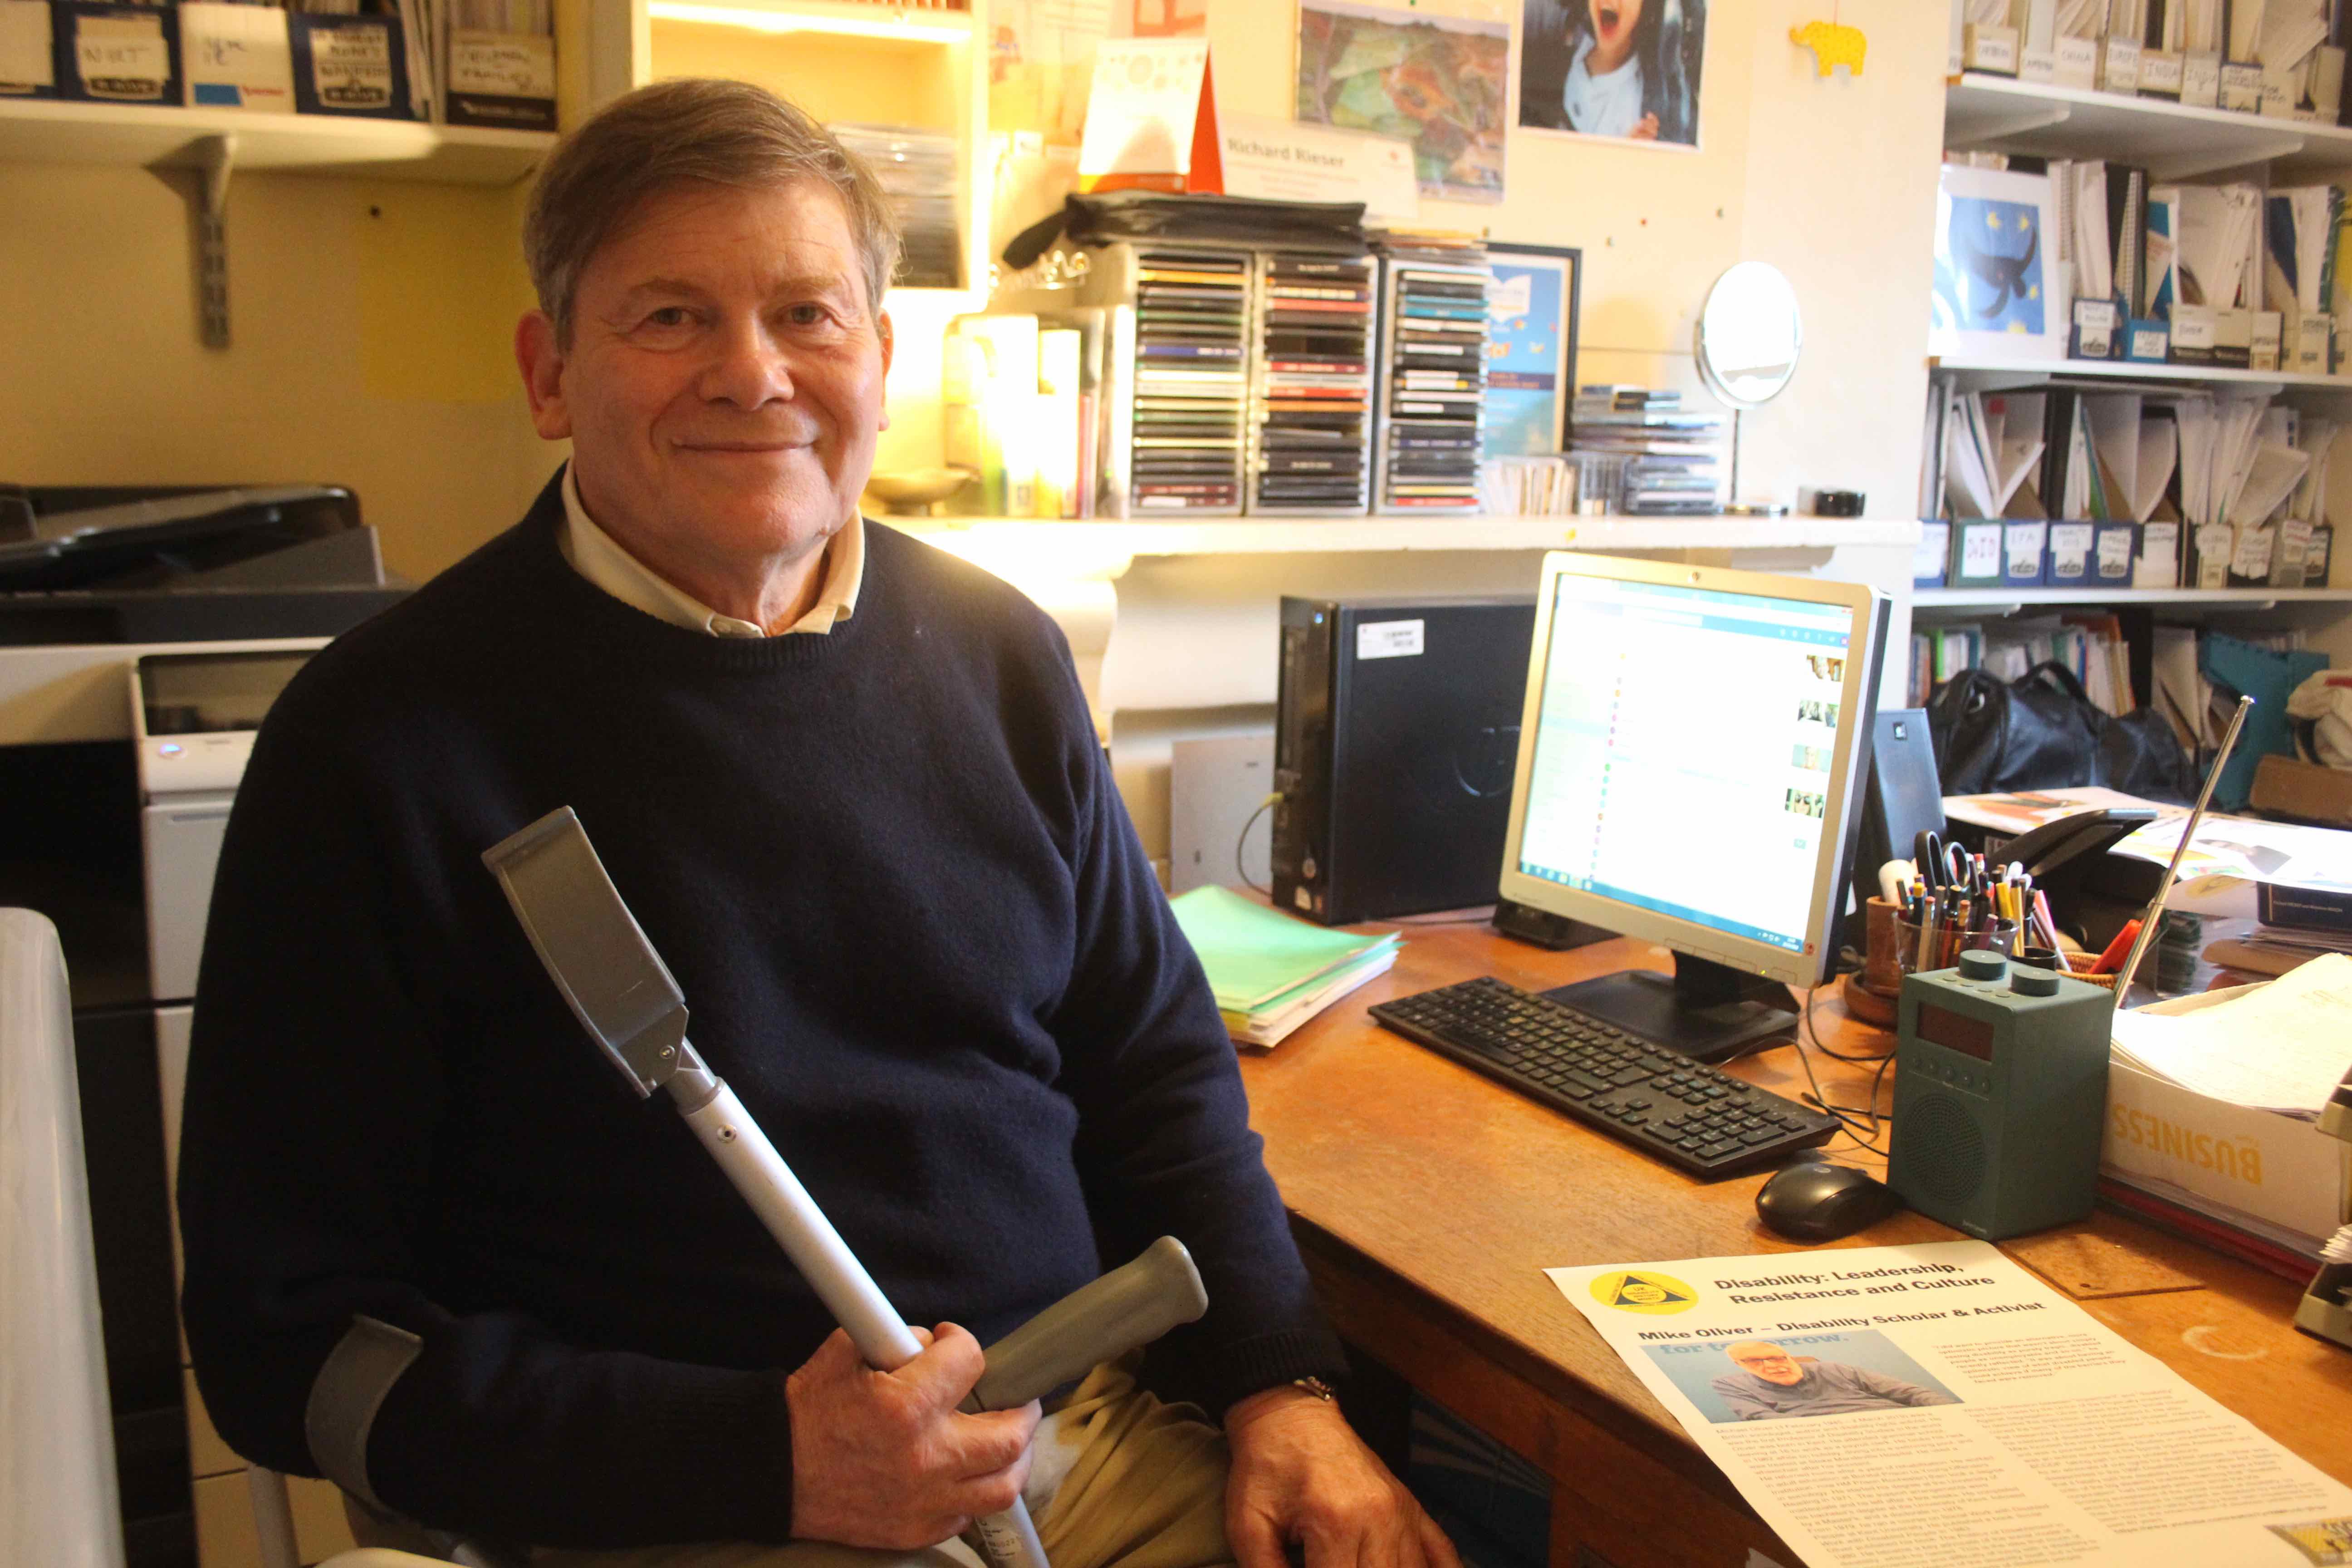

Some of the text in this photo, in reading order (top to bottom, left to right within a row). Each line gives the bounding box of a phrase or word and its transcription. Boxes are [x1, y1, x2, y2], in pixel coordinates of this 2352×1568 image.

[1226, 138, 1344, 167] Richard Rieser
[2112, 1103, 2264, 1186] BUSINESS
[1714, 1262, 1965, 1290] Disability: Leadership,
[1729, 1276, 1995, 1304] Resistance and Culture
[1638, 1329, 1691, 1340] Mike
[1695, 1326, 1754, 1338] Oliver
[1776, 1316, 1870, 1332] Disability
[1872, 1310, 1947, 1324] Scholar
[1972, 1302, 2046, 1315] Activist
[1660, 1343, 1705, 1355] for
